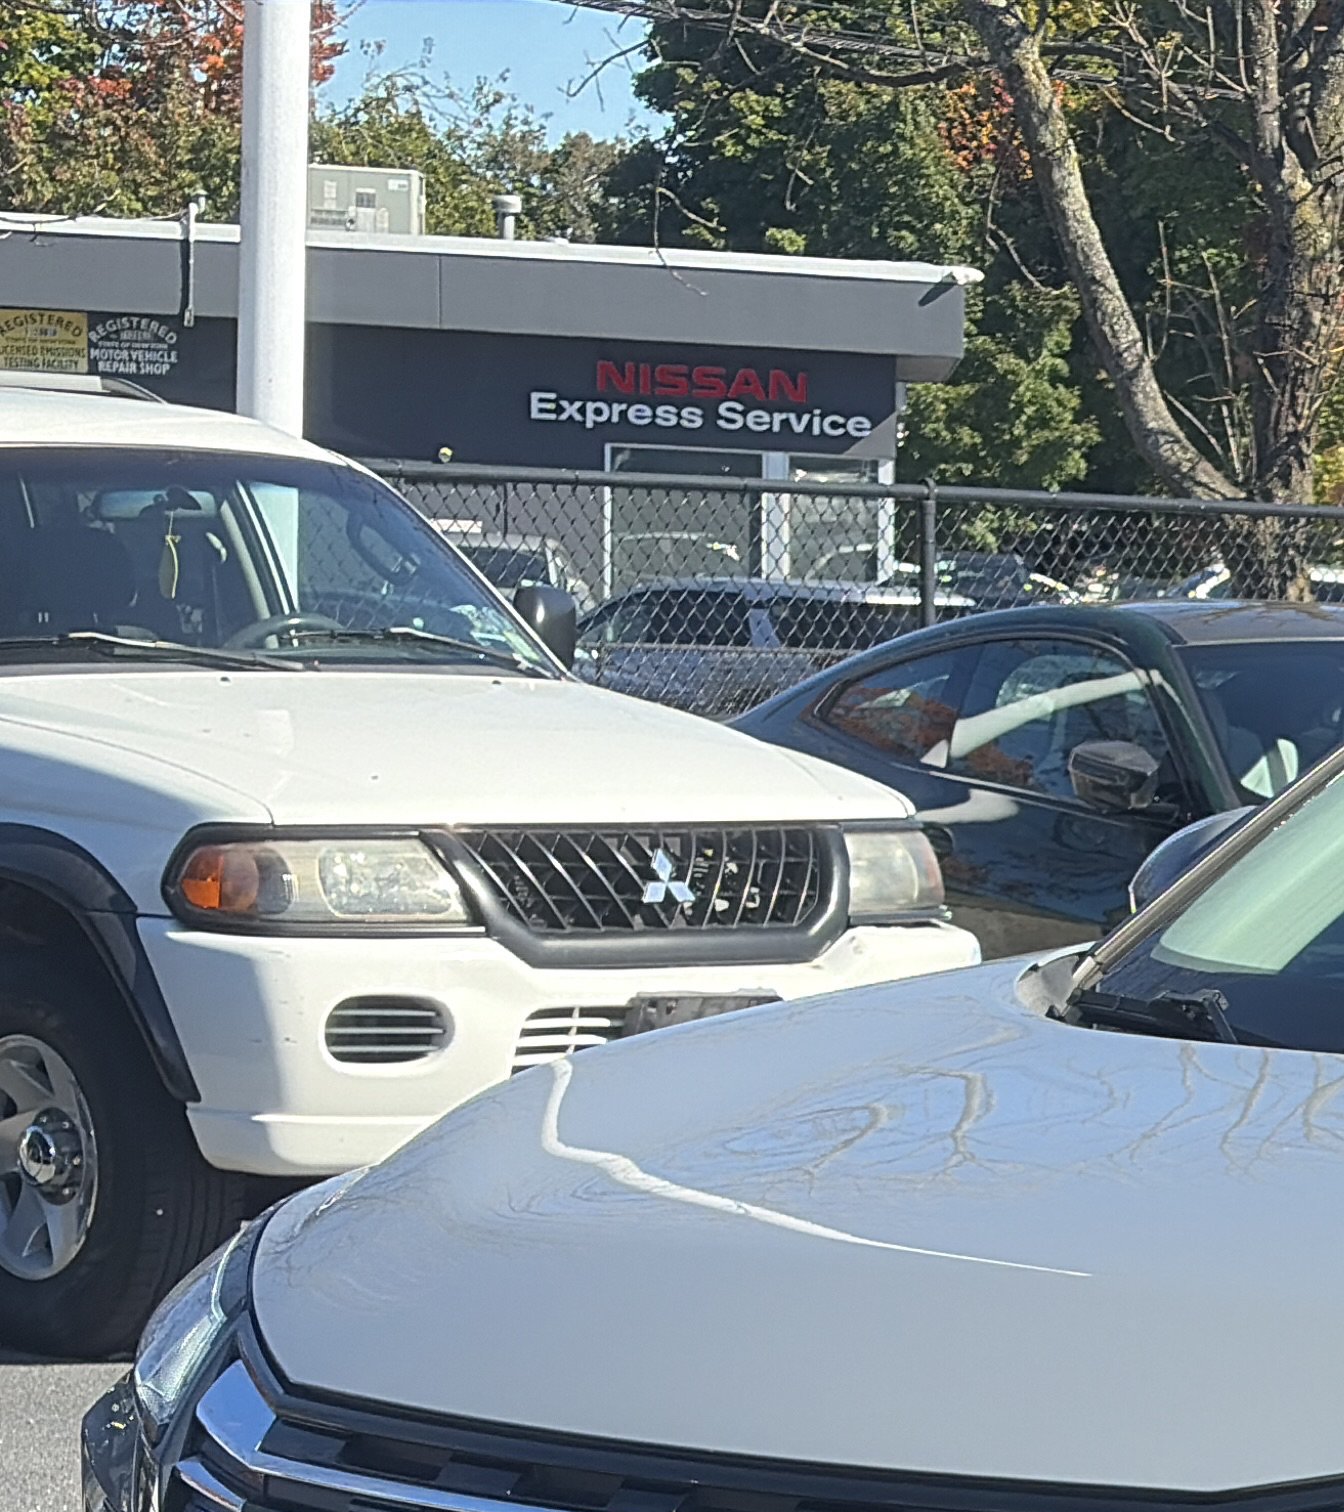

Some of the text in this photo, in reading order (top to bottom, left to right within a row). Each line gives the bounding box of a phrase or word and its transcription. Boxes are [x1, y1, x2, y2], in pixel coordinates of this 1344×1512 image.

[88, 316, 177, 344] REGISTERED
[90, 347, 178, 363] MOTOR VEHICLE
[97, 360, 171, 376] REPAIR SHOP
[596, 359, 808, 404] NISSAN
[529, 391, 873, 438] Express Service
